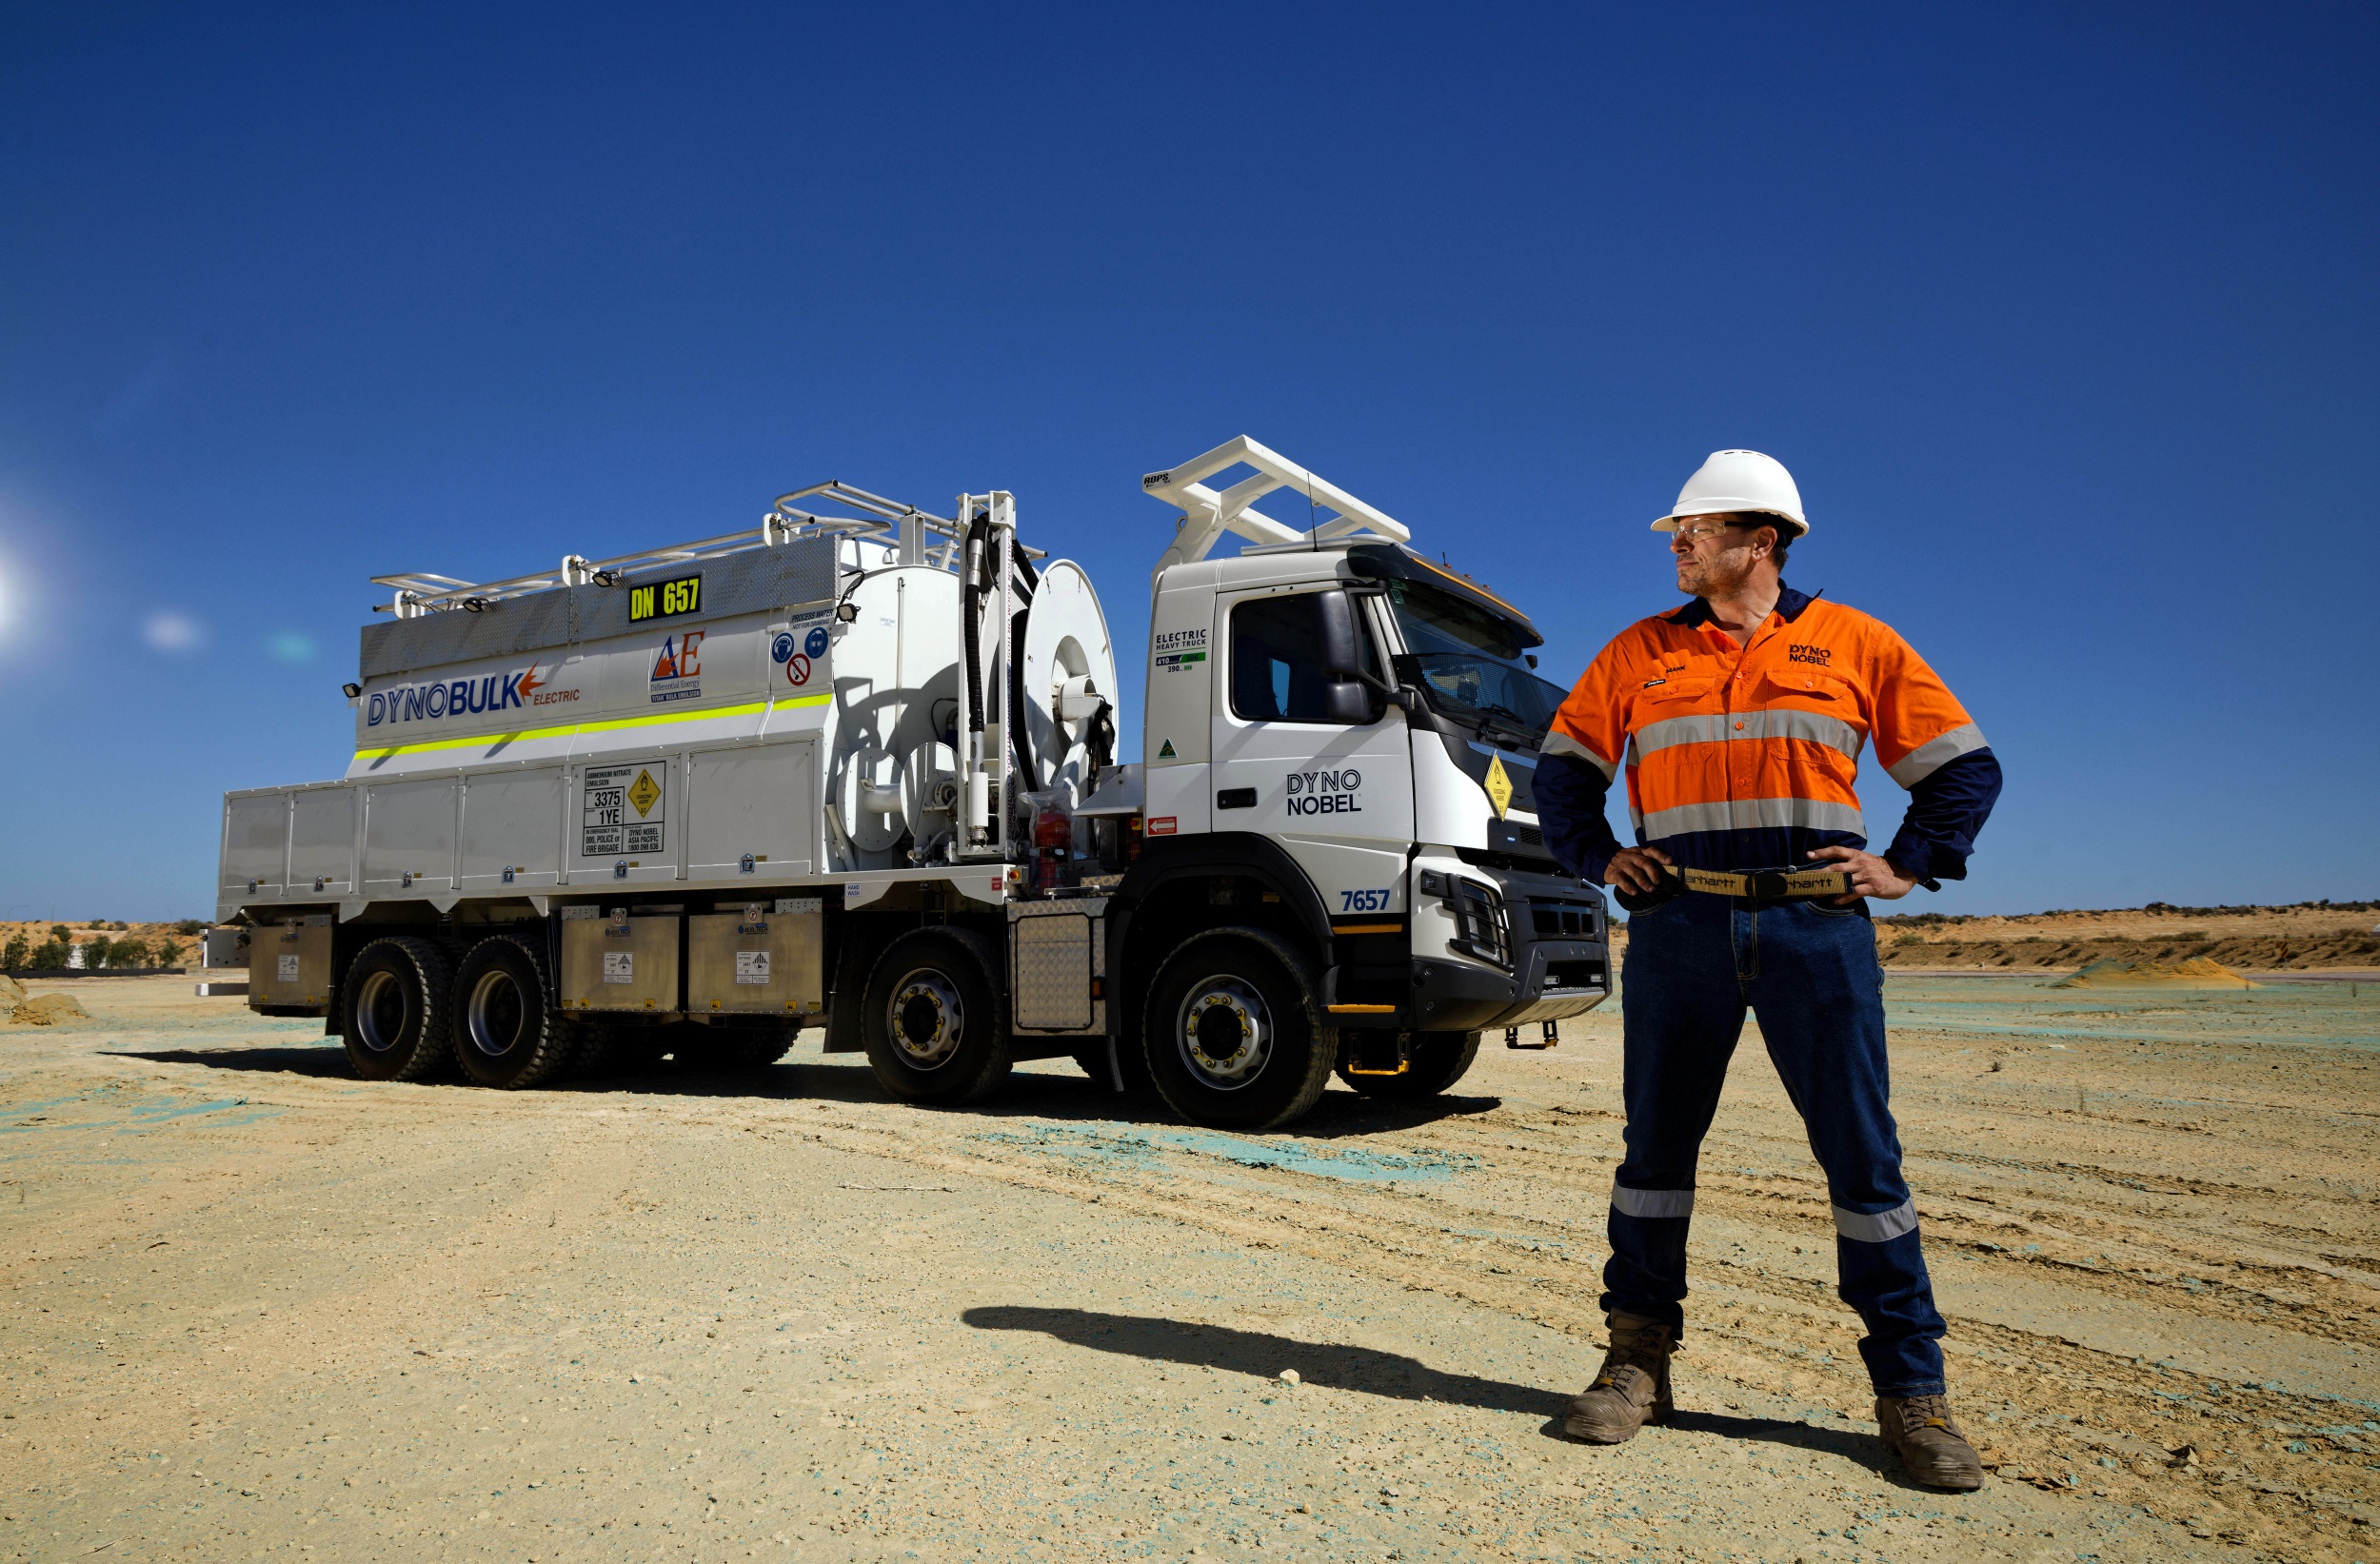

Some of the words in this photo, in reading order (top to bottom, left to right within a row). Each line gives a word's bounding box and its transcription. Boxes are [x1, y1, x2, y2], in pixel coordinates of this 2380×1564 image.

[1144, 472, 1169, 485] ROPS
[631, 586, 654, 620] DN
[664, 579, 699, 614] 657
[792, 611, 815, 623] PROCESS
[816, 608, 834, 619] WATER
[810, 619, 830, 627] DRINKING
[1157, 629, 1206, 643] ELECTRIC
[1157, 642, 1179, 650] HEAVY
[1182, 639, 1205, 647] TRUCK
[1789, 644, 1831, 658] DYNO
[1790, 654, 1830, 666] NOBEL
[651, 681, 680, 692] Differential
[680, 680, 700, 688] Energy
[367, 672, 525, 726] DYNOBULK
[533, 689, 580, 706] ELECTRIC
[651, 694, 664, 703] TITAN
[678, 690, 700, 699] EMULSION
[587, 770, 612, 779] AMMONIUM
[587, 779, 609, 787] EMULSION
[1287, 769, 1361, 794] DYNO
[594, 791, 621, 806] 3375
[1287, 794, 1361, 816] NOBEL
[600, 809, 619, 824] 1YE
[597, 835, 614, 843] POLICE
[598, 843, 619, 853] BRIGADE
[1685, 876, 1735, 887] arhartt
[1787, 878, 1832, 888] rhartt
[1340, 889, 1390, 911] 7657
